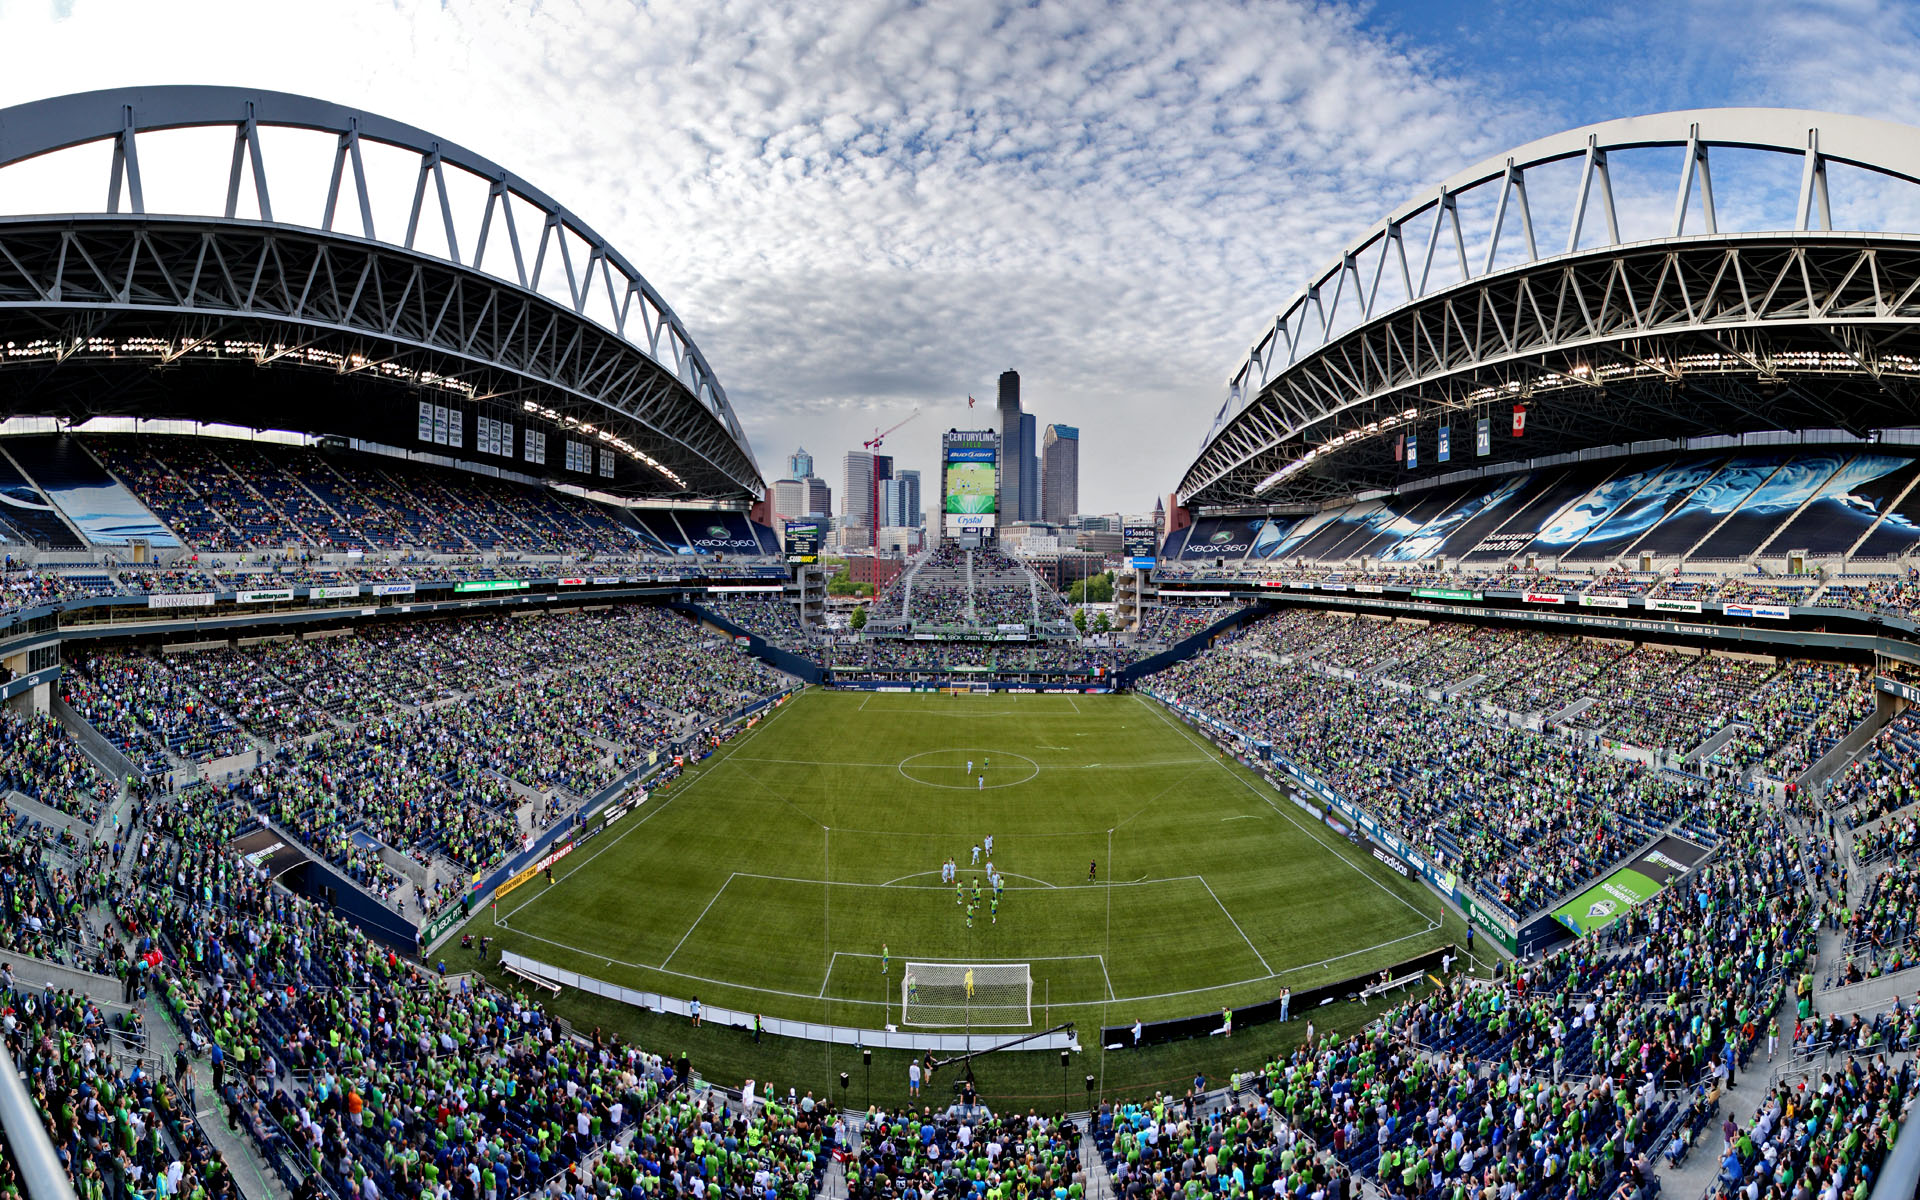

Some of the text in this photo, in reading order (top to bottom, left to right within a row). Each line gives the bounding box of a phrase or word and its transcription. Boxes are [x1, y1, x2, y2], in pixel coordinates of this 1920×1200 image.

[1440, 440, 1448, 453] 12
[957, 516, 983, 525] Crystal
[693, 539, 755, 547] XBOX 360
[1222, 544, 1247, 552] 360
[155, 596, 205, 607] PINNACLE
[537, 854, 553, 872] ROOT
[1383, 855, 1408, 876] adidas
